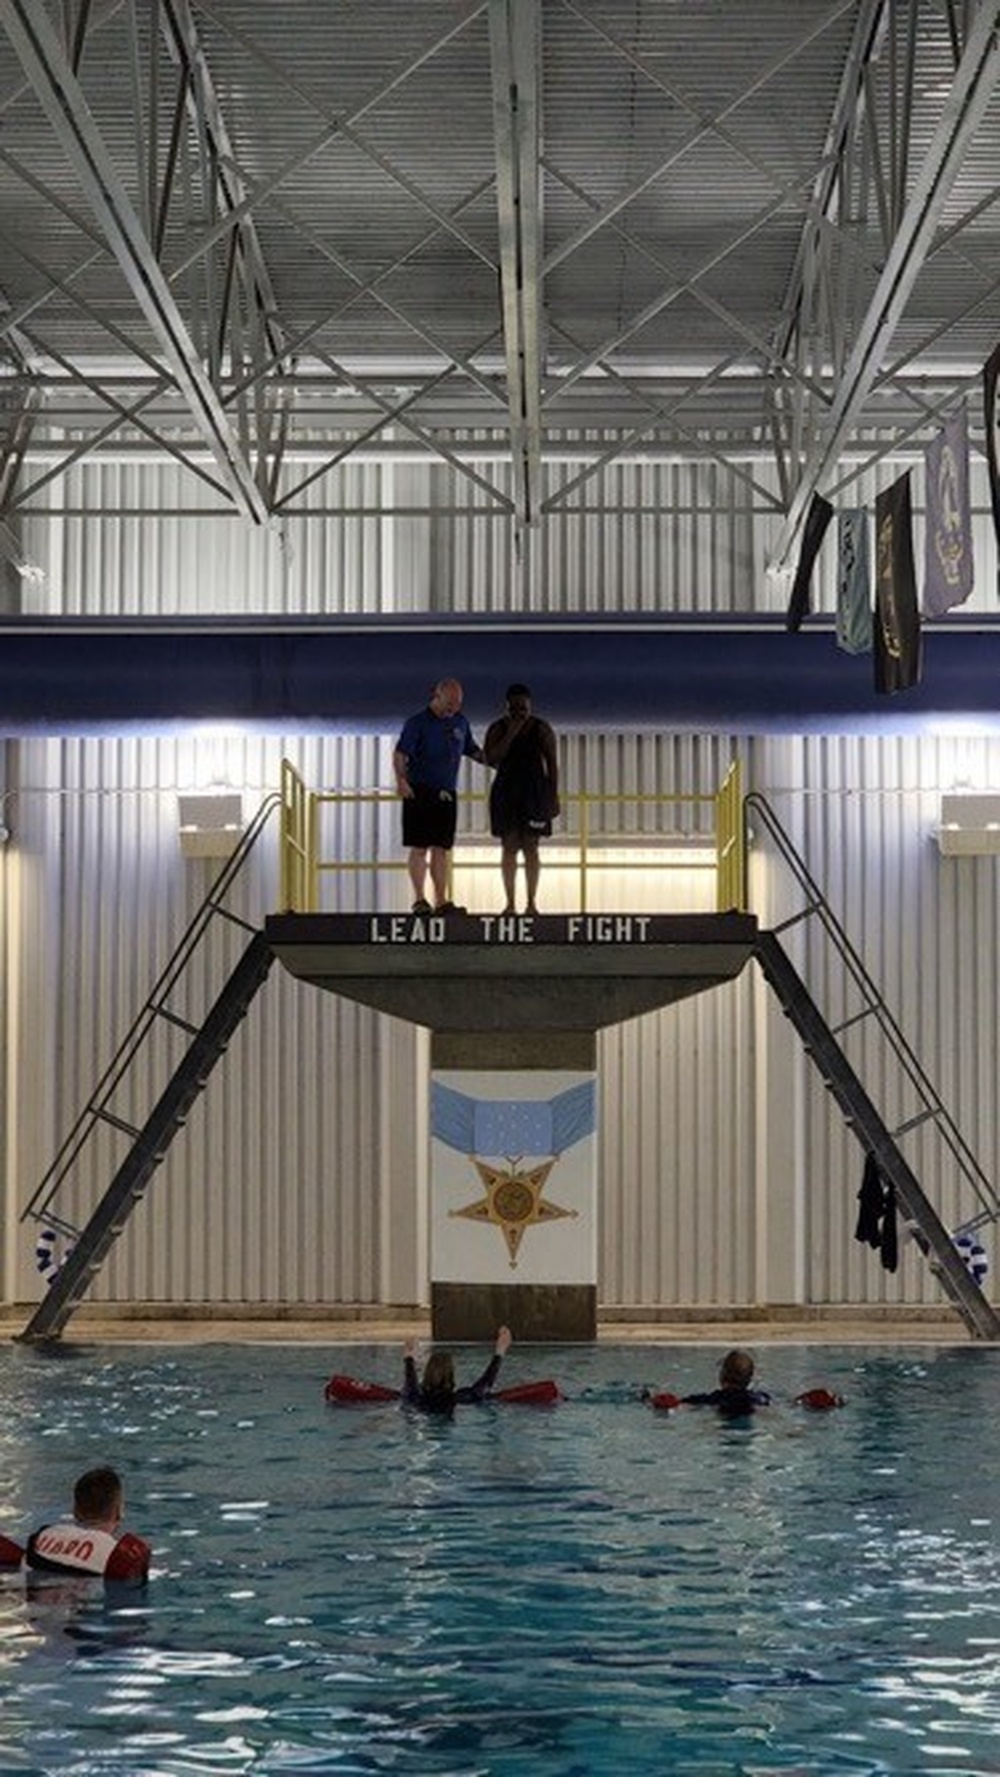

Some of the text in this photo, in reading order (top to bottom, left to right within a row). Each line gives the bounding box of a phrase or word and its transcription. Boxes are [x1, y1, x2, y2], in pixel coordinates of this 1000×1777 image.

[371, 917, 651, 942] LEAD THE FIGHT
